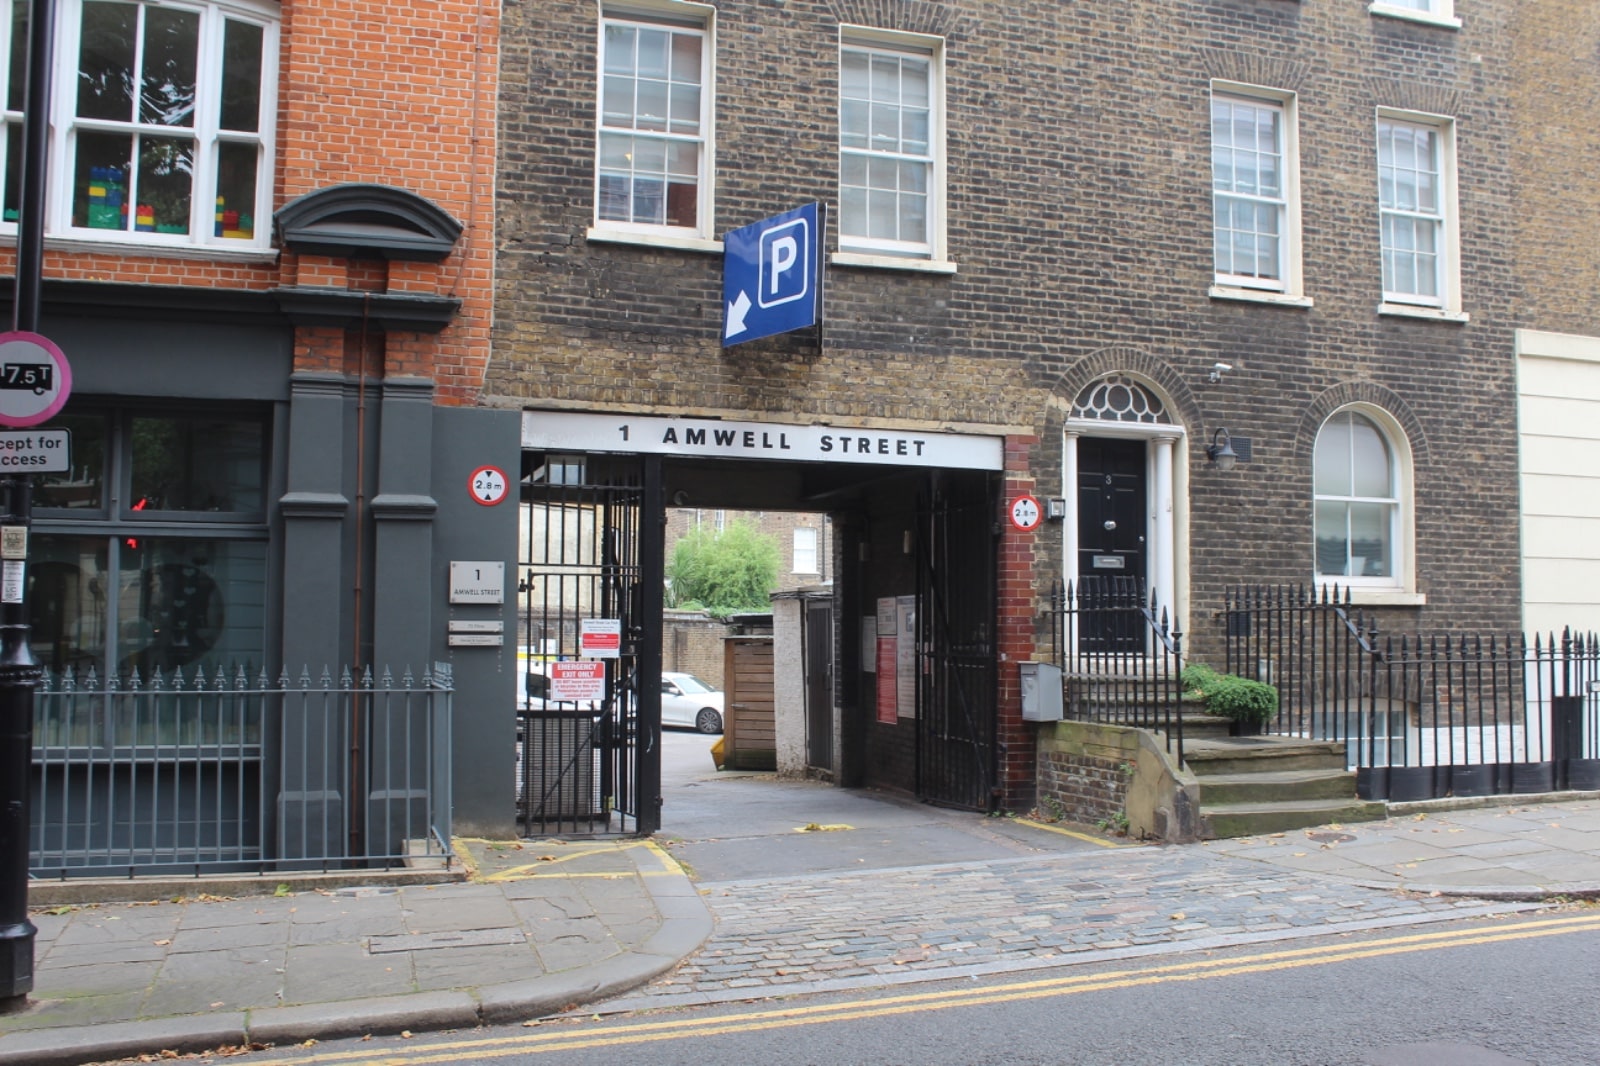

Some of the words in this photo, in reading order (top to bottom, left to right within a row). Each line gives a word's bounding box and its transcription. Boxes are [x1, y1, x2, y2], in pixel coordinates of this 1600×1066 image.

[771, 236, 797, 295] P
[38, 436, 62, 449] for
[618, 425, 629, 441] 1
[662, 427, 791, 450] AMWELL
[820, 435, 925, 456] STREET
[1105, 474, 1112, 485] 3
[475, 569, 480, 581] 1
[454, 588, 480, 596] AMWELL
[557, 663, 597, 671] EMERGENCY
